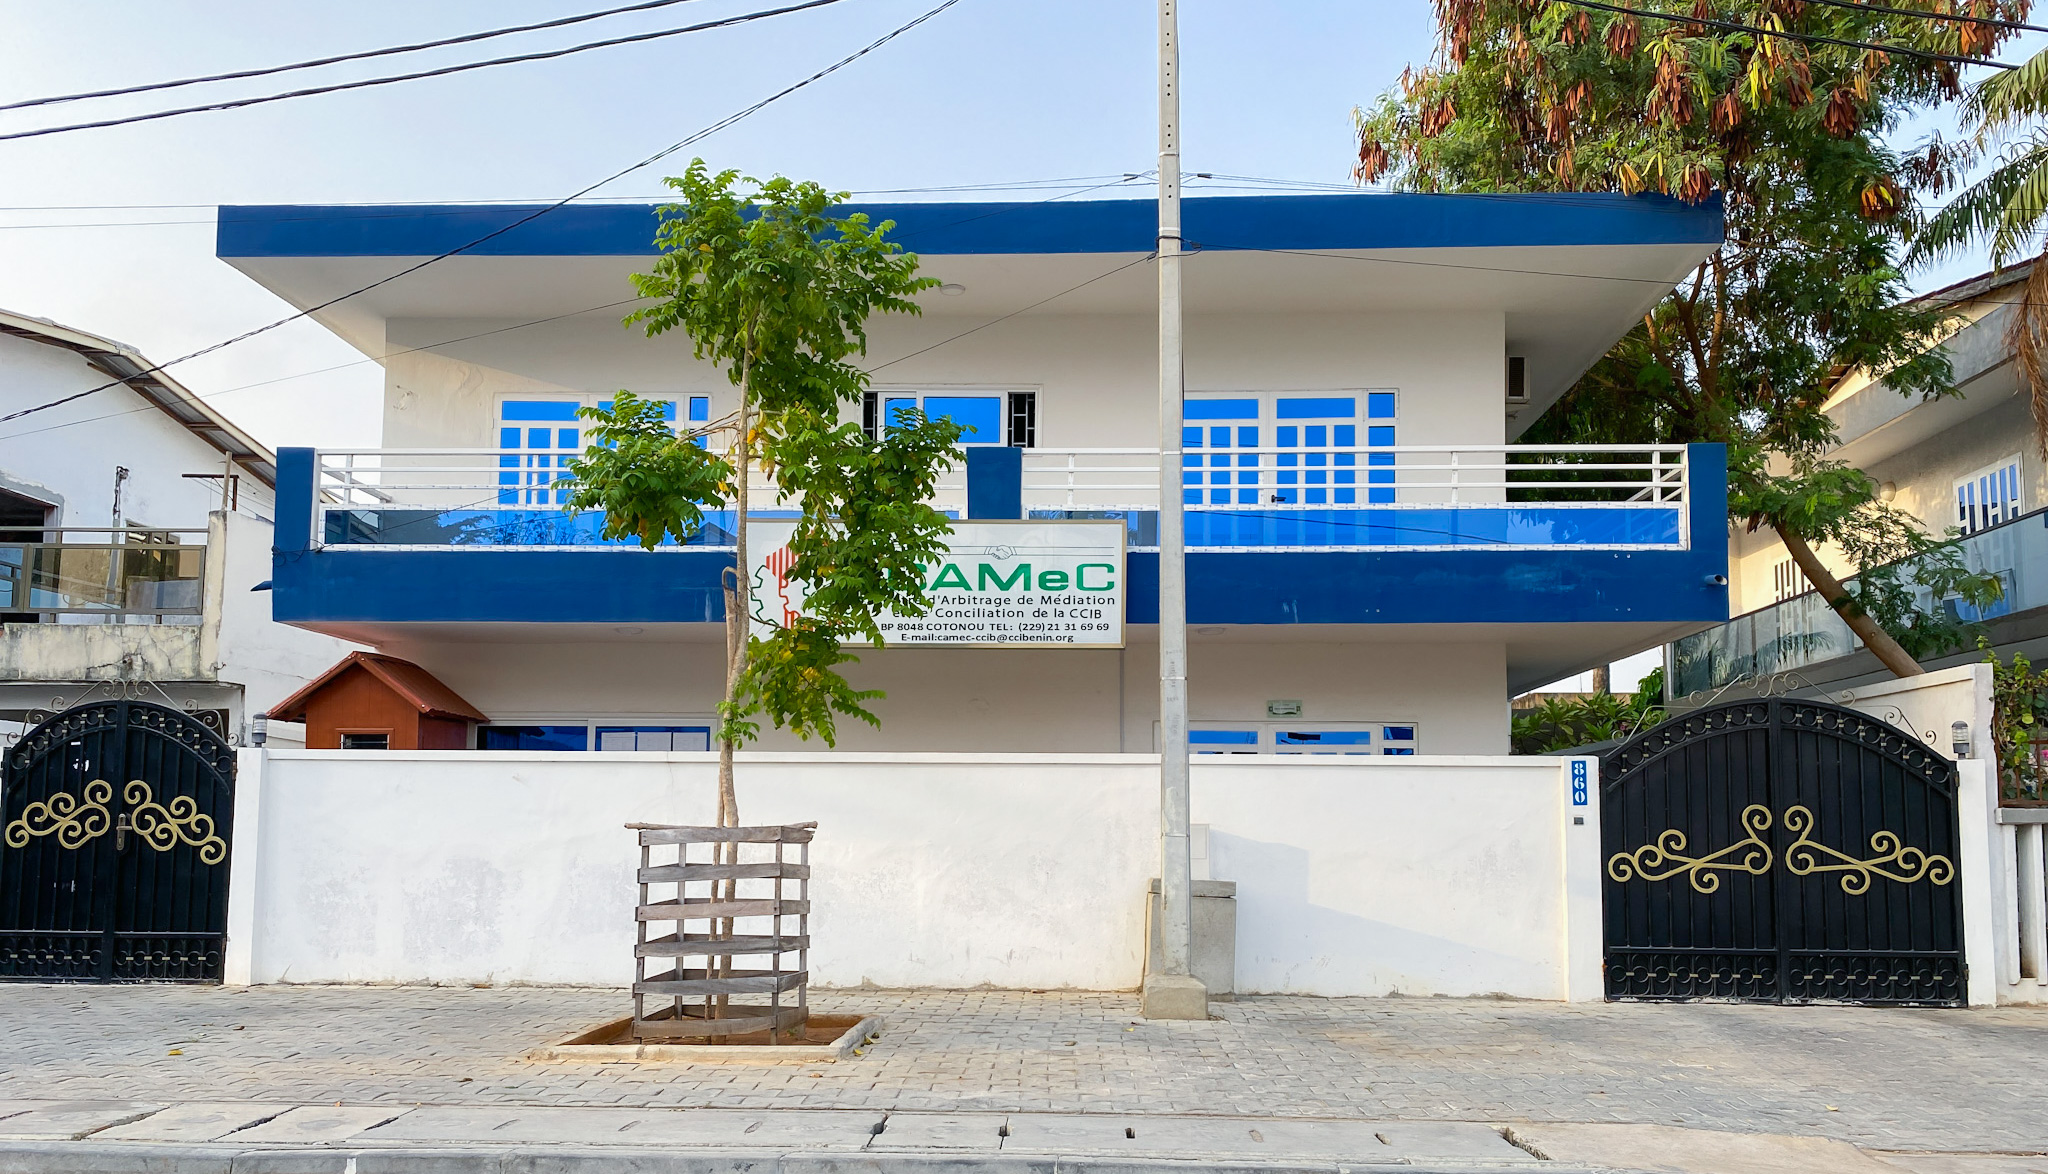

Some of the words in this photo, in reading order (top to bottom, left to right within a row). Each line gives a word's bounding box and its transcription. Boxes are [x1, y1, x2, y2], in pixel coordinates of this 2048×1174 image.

[928, 594, 1011, 607] d'Arbitrage
[1017, 594, 1034, 605] de
[1040, 593, 1116, 605] Médiation
[935, 608, 1024, 618] Conciliation
[1032, 608, 1049, 618] de
[1054, 608, 1065, 618] la
[1069, 608, 1103, 619] CCIB
[881, 623, 894, 631] BP
[896, 623, 924, 631] 8048
[926, 623, 985, 631] COTONOU
[989, 623, 1013, 631] TEL:
[1018, 622, 1045, 632] (229)
[1047, 623, 1060, 631] 21
[1064, 623, 1077, 631] 31
[1080, 623, 1093, 631] 69
[1096, 623, 1109, 631] 69
[901, 633, 1074, 643] E-mail:camec-ccib@ccibenin.org
[1573, 762, 1586, 804] 860
